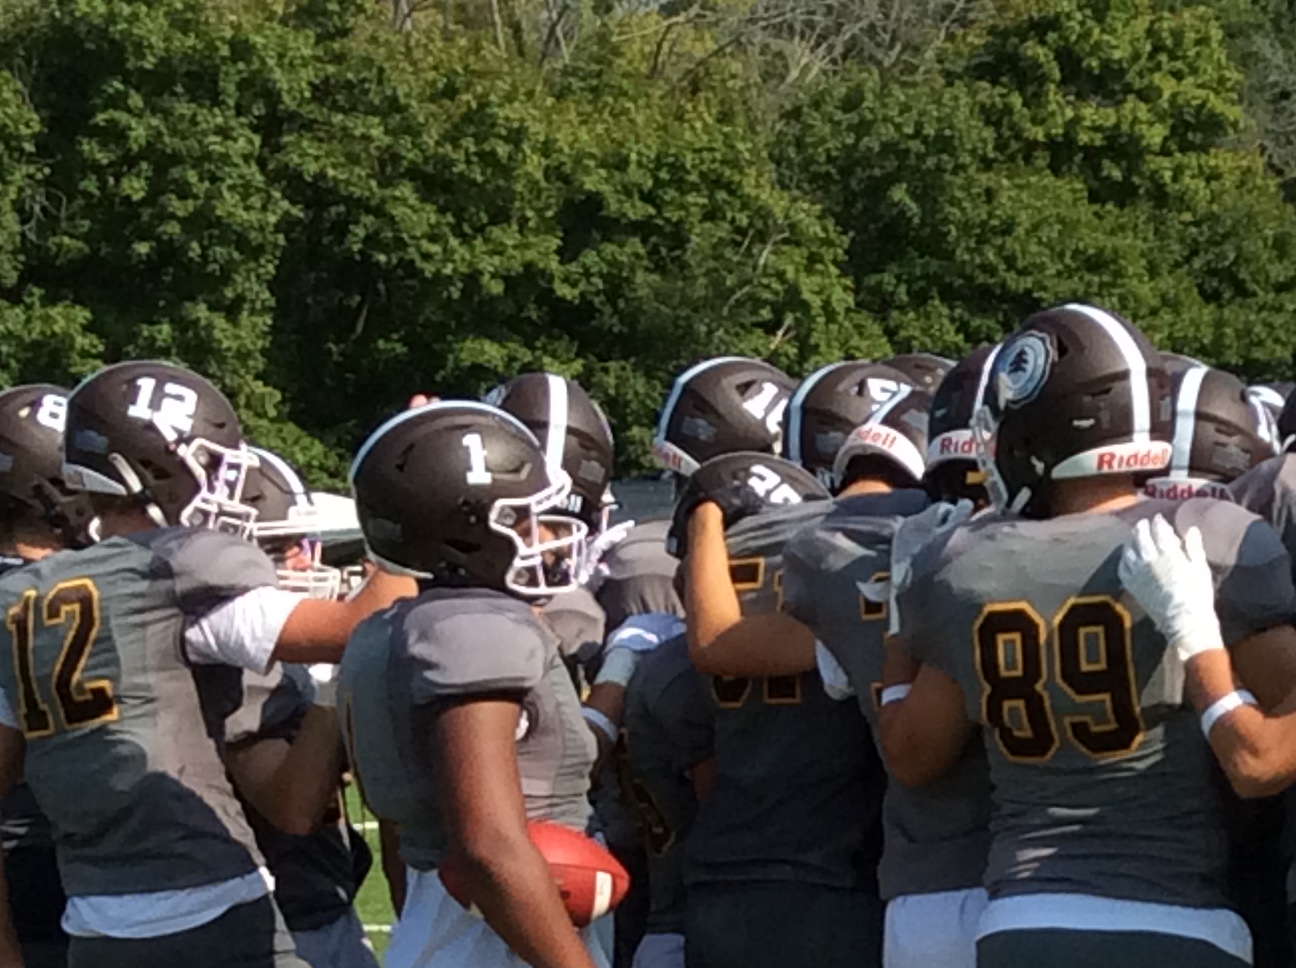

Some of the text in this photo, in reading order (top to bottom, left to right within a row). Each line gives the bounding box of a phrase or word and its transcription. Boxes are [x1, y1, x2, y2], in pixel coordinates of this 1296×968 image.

[126, 376, 198, 442] 12
[462, 433, 492, 485] 1
[6, 577, 120, 740] 12
[972, 593, 1147, 765] 89
